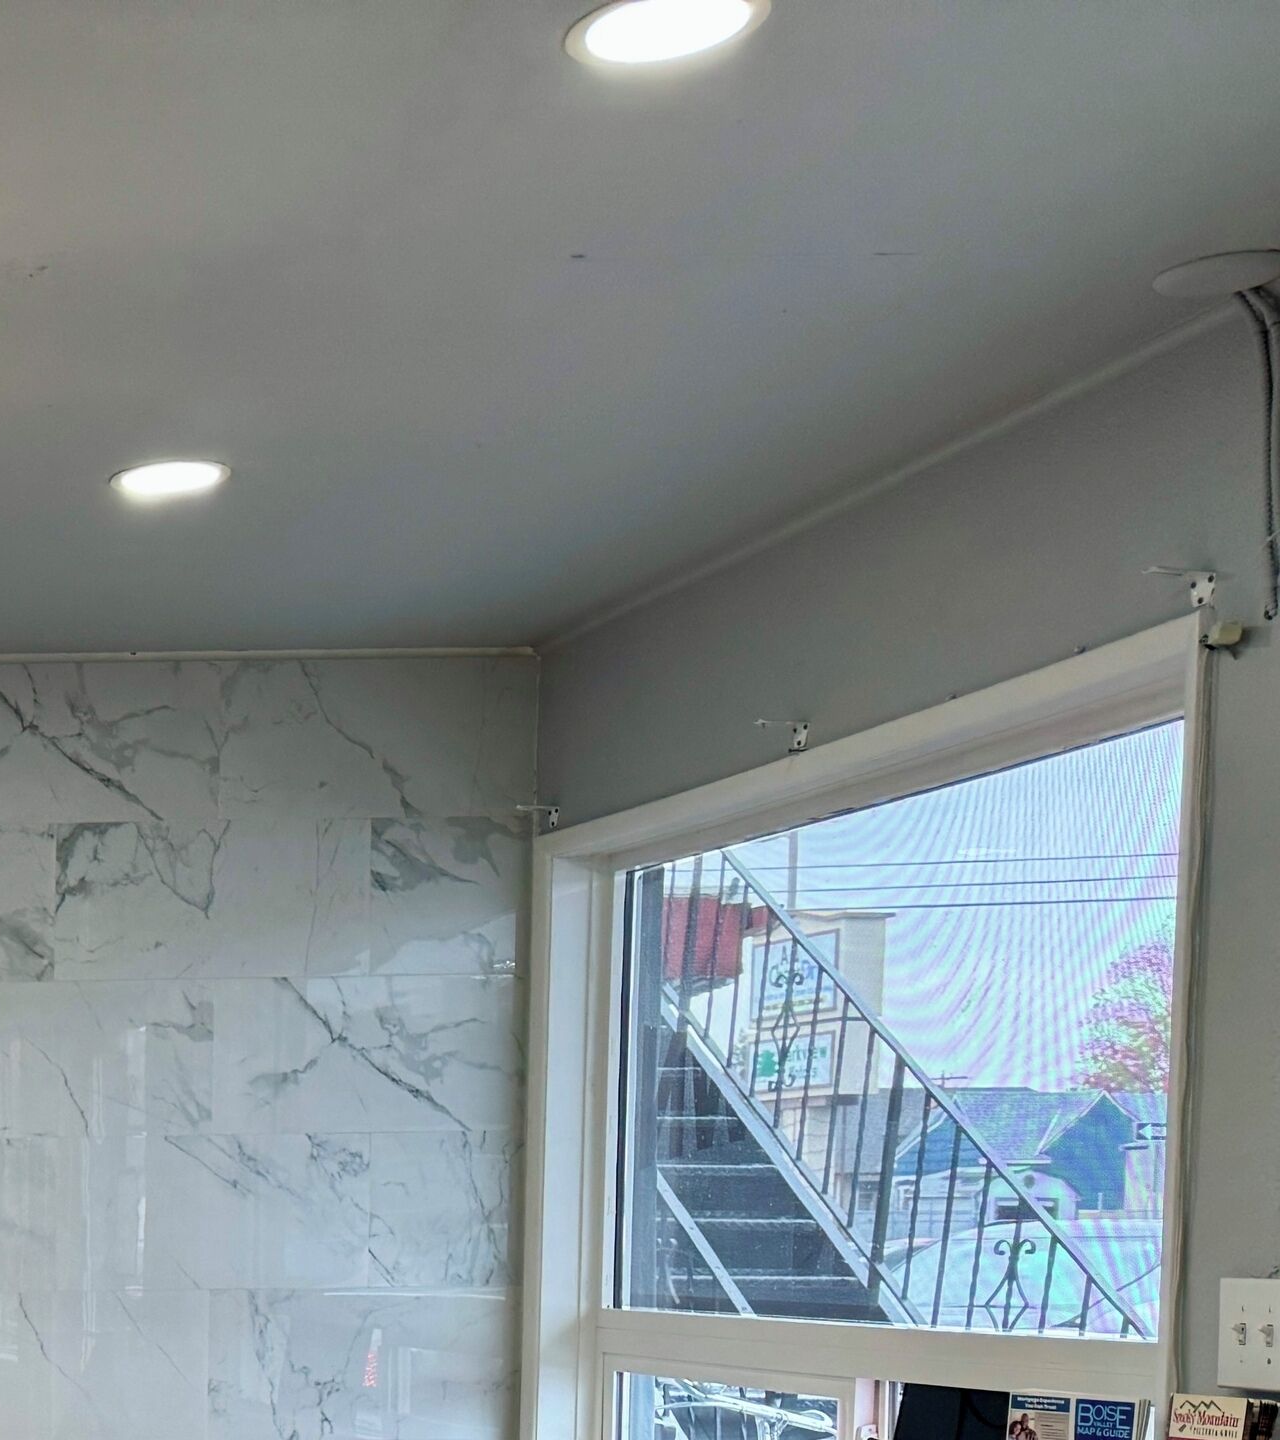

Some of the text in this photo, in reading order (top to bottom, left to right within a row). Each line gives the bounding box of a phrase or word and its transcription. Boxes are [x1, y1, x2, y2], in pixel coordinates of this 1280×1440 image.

[1077, 1403, 1132, 1431] BOISE
[1077, 1426, 1095, 1436] MAP
[1103, 1429, 1131, 1439] GUIDE
